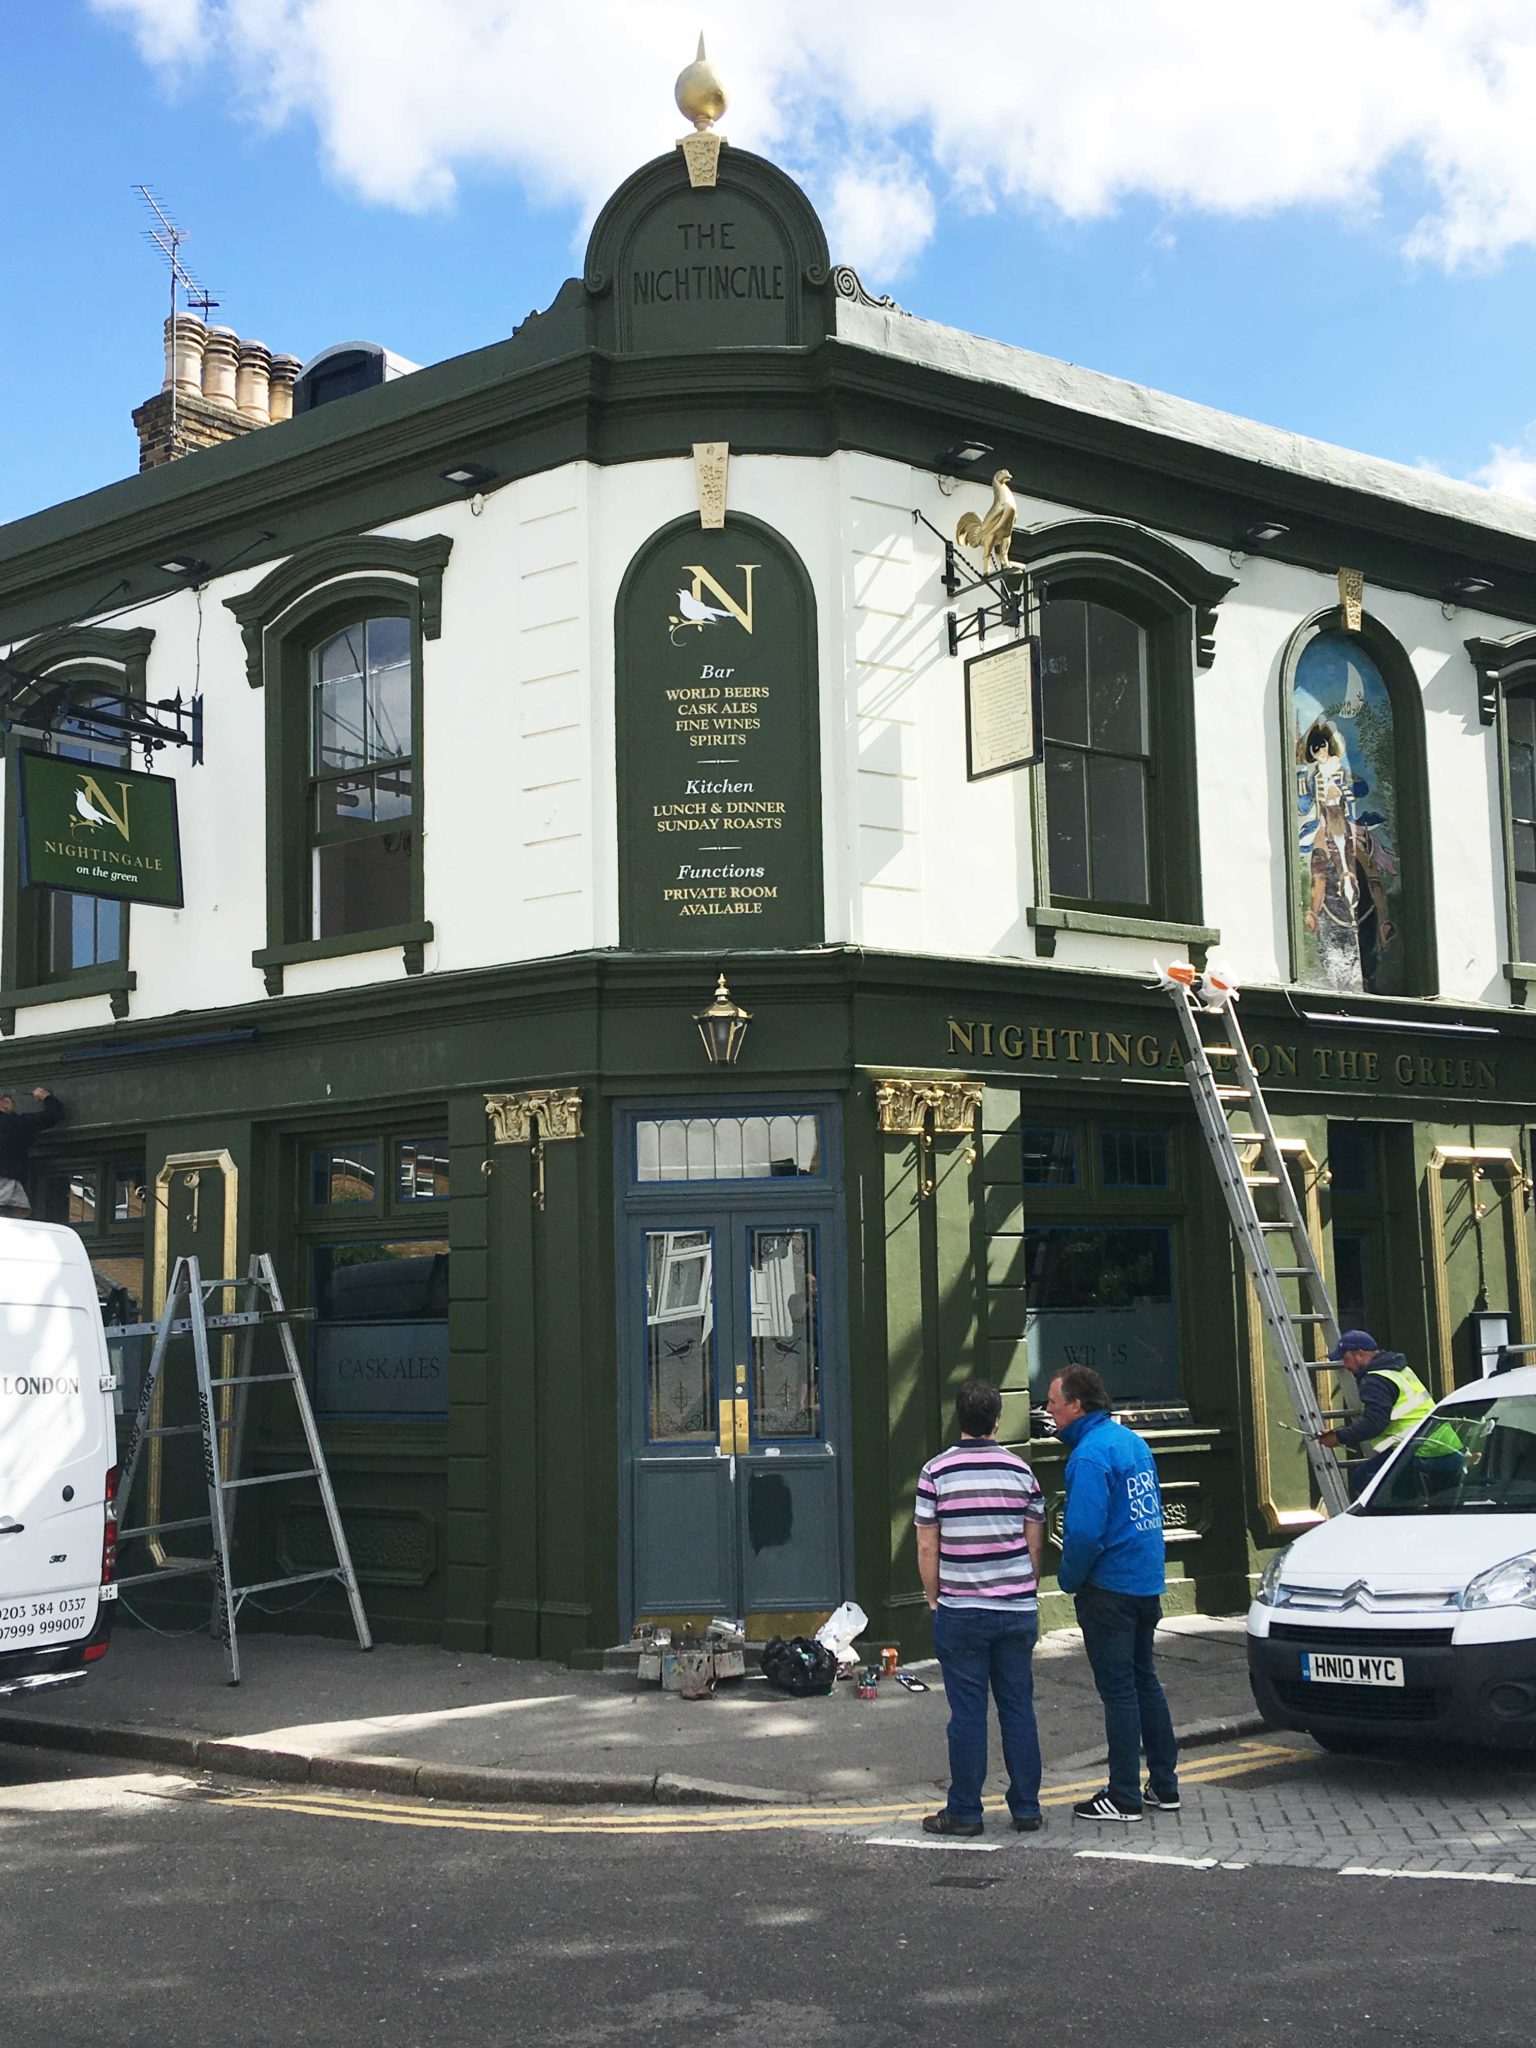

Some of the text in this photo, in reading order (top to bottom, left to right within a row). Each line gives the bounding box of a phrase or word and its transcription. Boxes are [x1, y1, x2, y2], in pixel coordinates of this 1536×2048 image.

[678, 222, 735, 250] THE
[700, 664, 735, 679] Bar
[665, 686, 770, 701] WORLD BEERS
[677, 702, 758, 716] CASK ALES
[675, 718, 761, 732] FINE WINES
[689, 733, 747, 747] SPIRITS
[685, 779, 754, 795] Kitchen
[653, 801, 786, 817] LUNCH & DINNER
[657, 817, 782, 832] SUNDAY ROASTS
[44, 840, 163, 871] NIGHTINGALE
[76, 865, 138, 883] on the green
[677, 863, 765, 880] Functions
[663, 886, 778, 901] PRIVATE ROOM
[679, 902, 762, 916] AVAILABLE
[947, 1019, 1499, 1090] NIGHTINGAE ON THE GREEN
[339, 1357, 440, 1380] CASK ALES
[3, 1376, 79, 1395] LONDON
[139, 1373, 155, 1416] SIGNS
[200, 1392, 211, 1432] SIGNS
[0, 1597, 86, 1621] 203 384 0337
[39, 1616, 85, 1635] 999007
[1314, 1656, 1397, 1681] HN10 MYC
